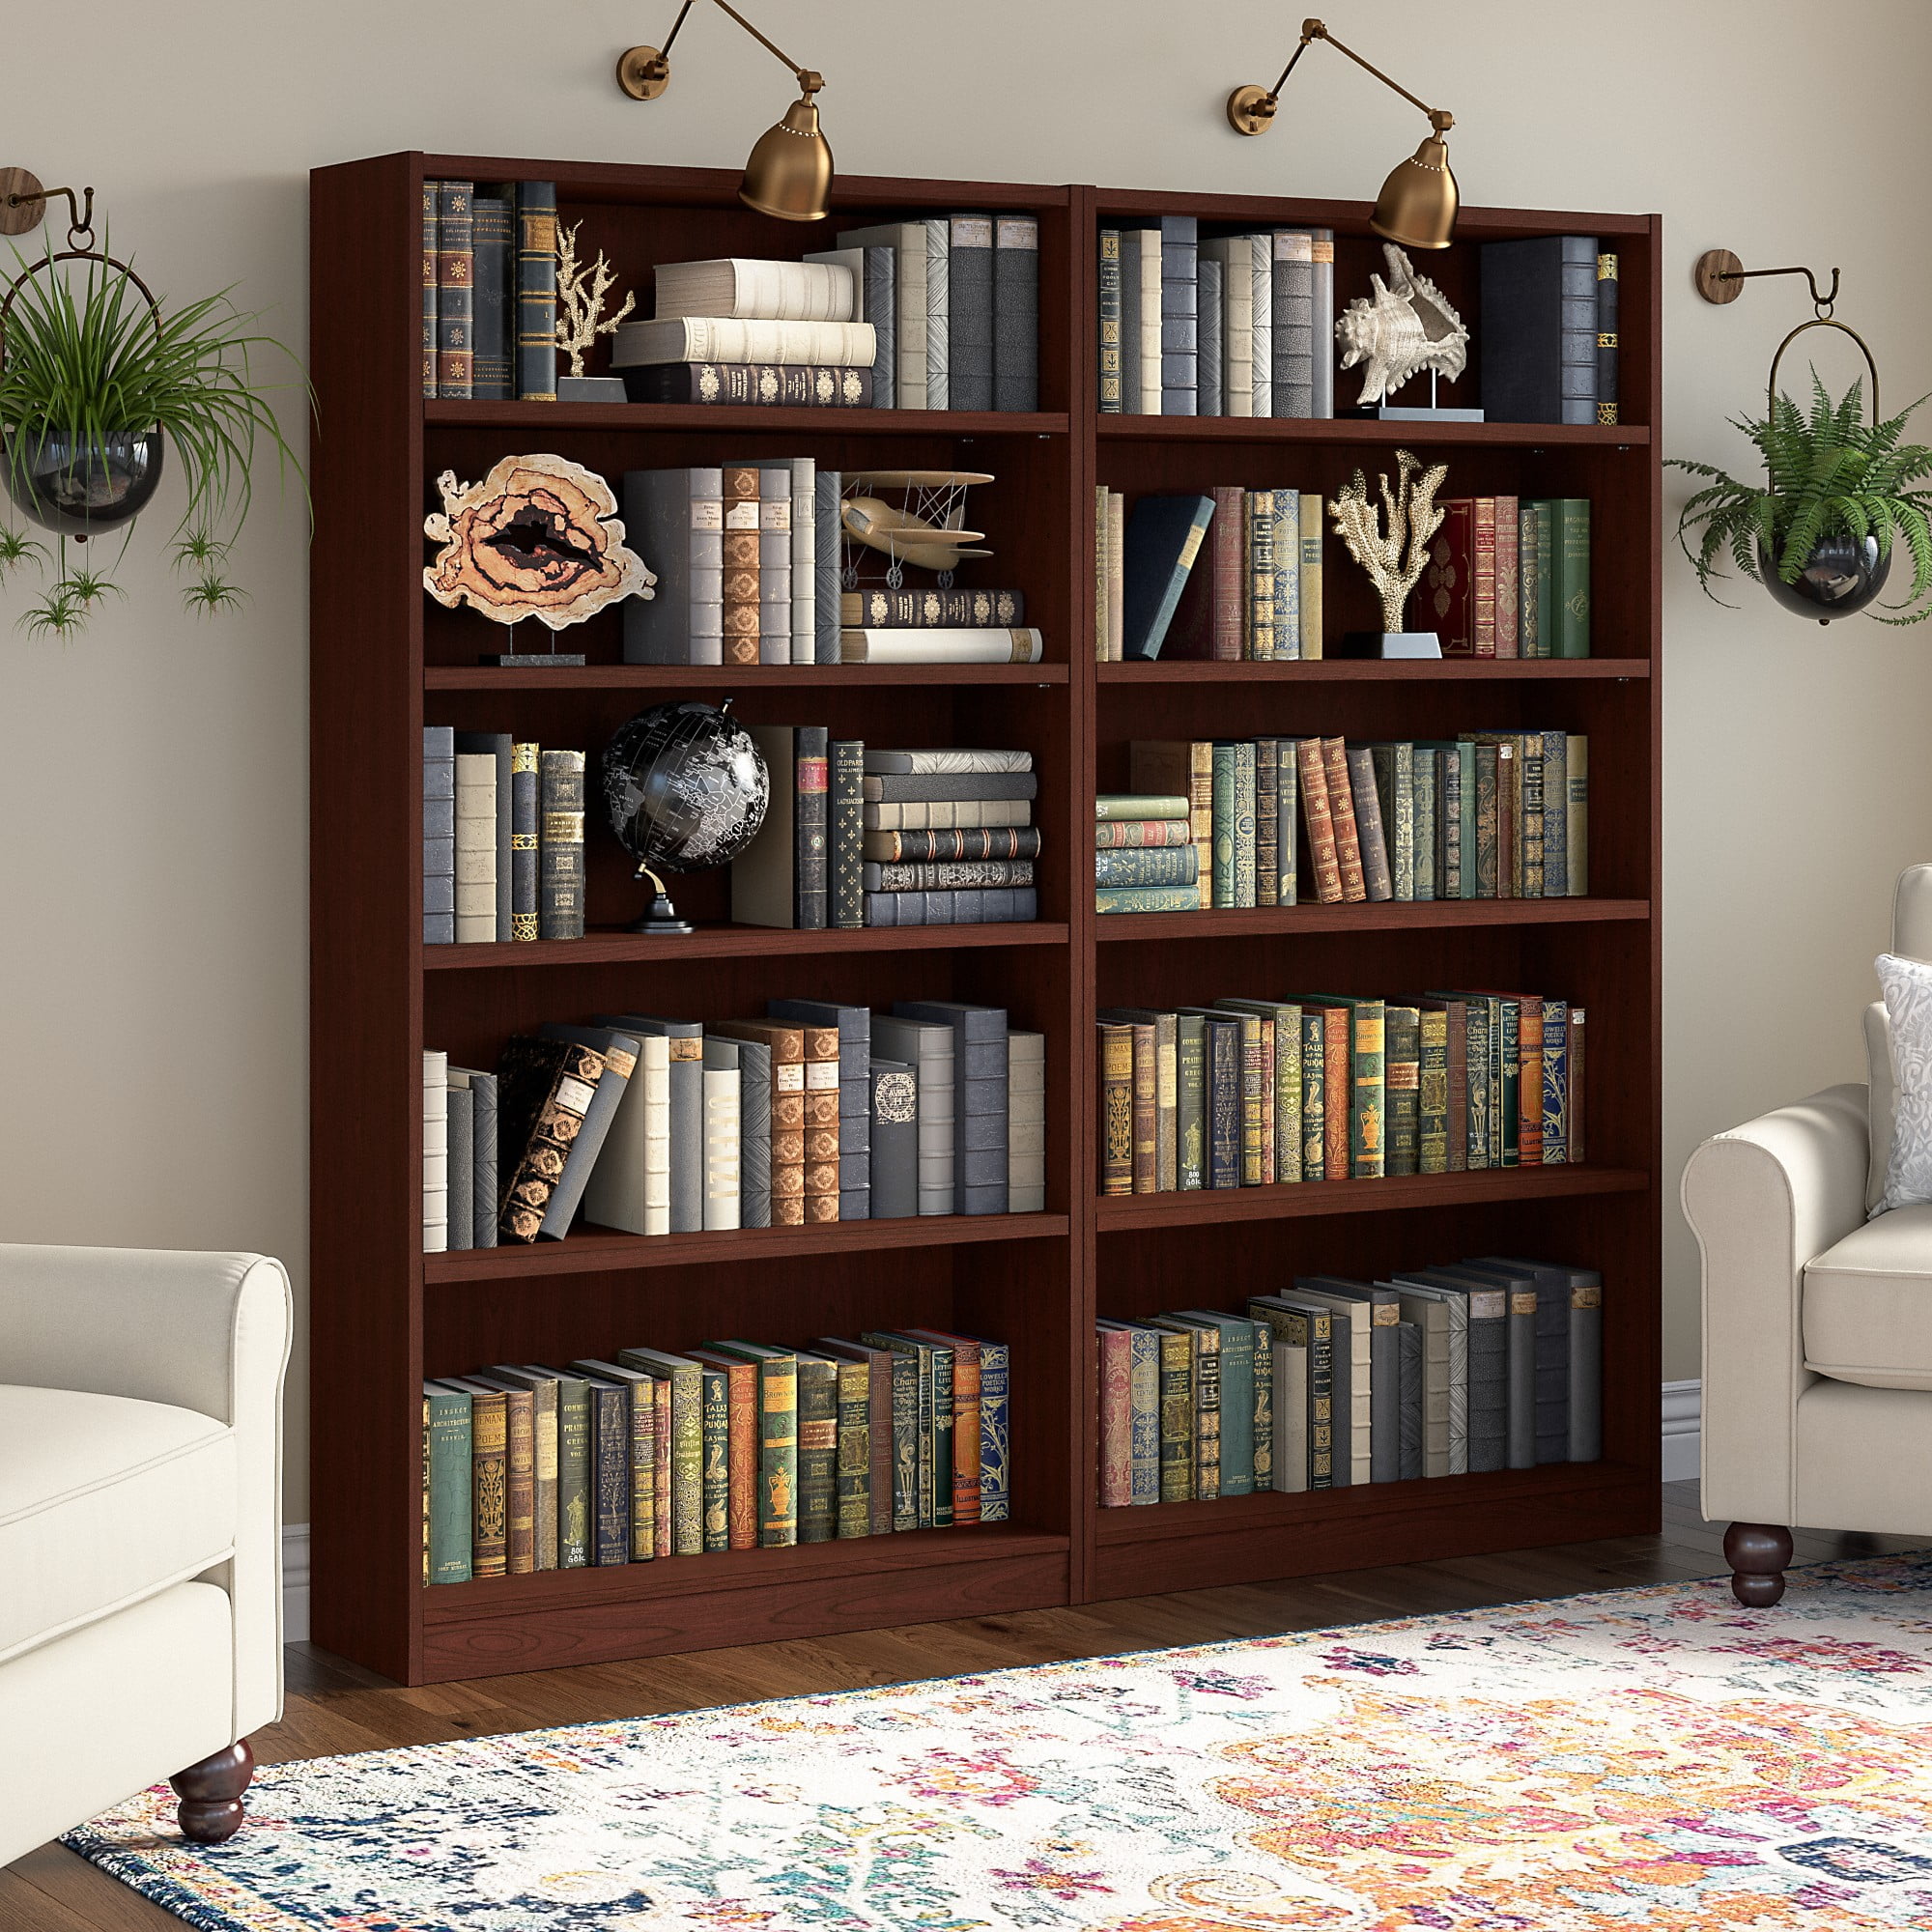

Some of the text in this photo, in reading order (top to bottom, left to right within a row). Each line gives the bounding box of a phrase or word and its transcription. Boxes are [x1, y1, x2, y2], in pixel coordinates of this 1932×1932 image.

[1102, 857, 1108, 872] PR
[708, 1096, 739, 1199] UFFIZI
[981, 1378, 1007, 1387] POETICAL
[440, 1406, 468, 1416] INSECT
[704, 1403, 727, 1413] TALES
[474, 1434, 506, 1446] POEMS
[571, 1547, 584, 1555] 800
